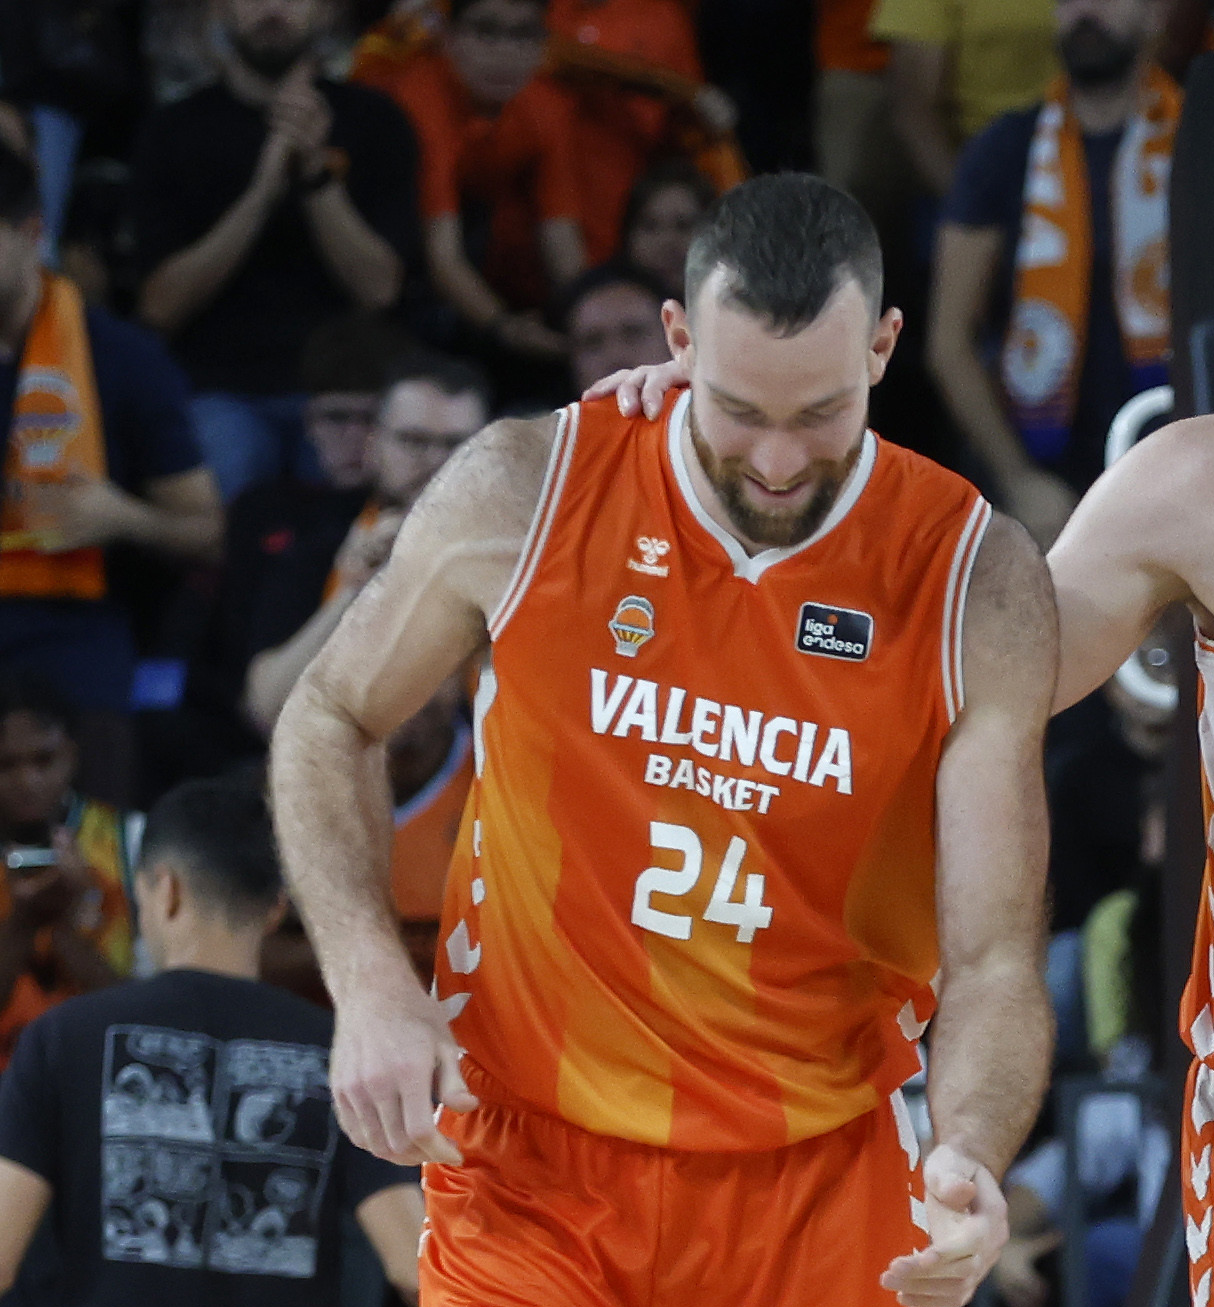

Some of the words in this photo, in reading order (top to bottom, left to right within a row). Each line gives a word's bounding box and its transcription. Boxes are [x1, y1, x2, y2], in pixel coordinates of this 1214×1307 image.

[802, 635, 865, 655] endesa
[805, 618, 835, 636] liga
[590, 668, 852, 795] VALENCIA
[644, 754, 780, 815] BASKET
[631, 821, 774, 943] 24
